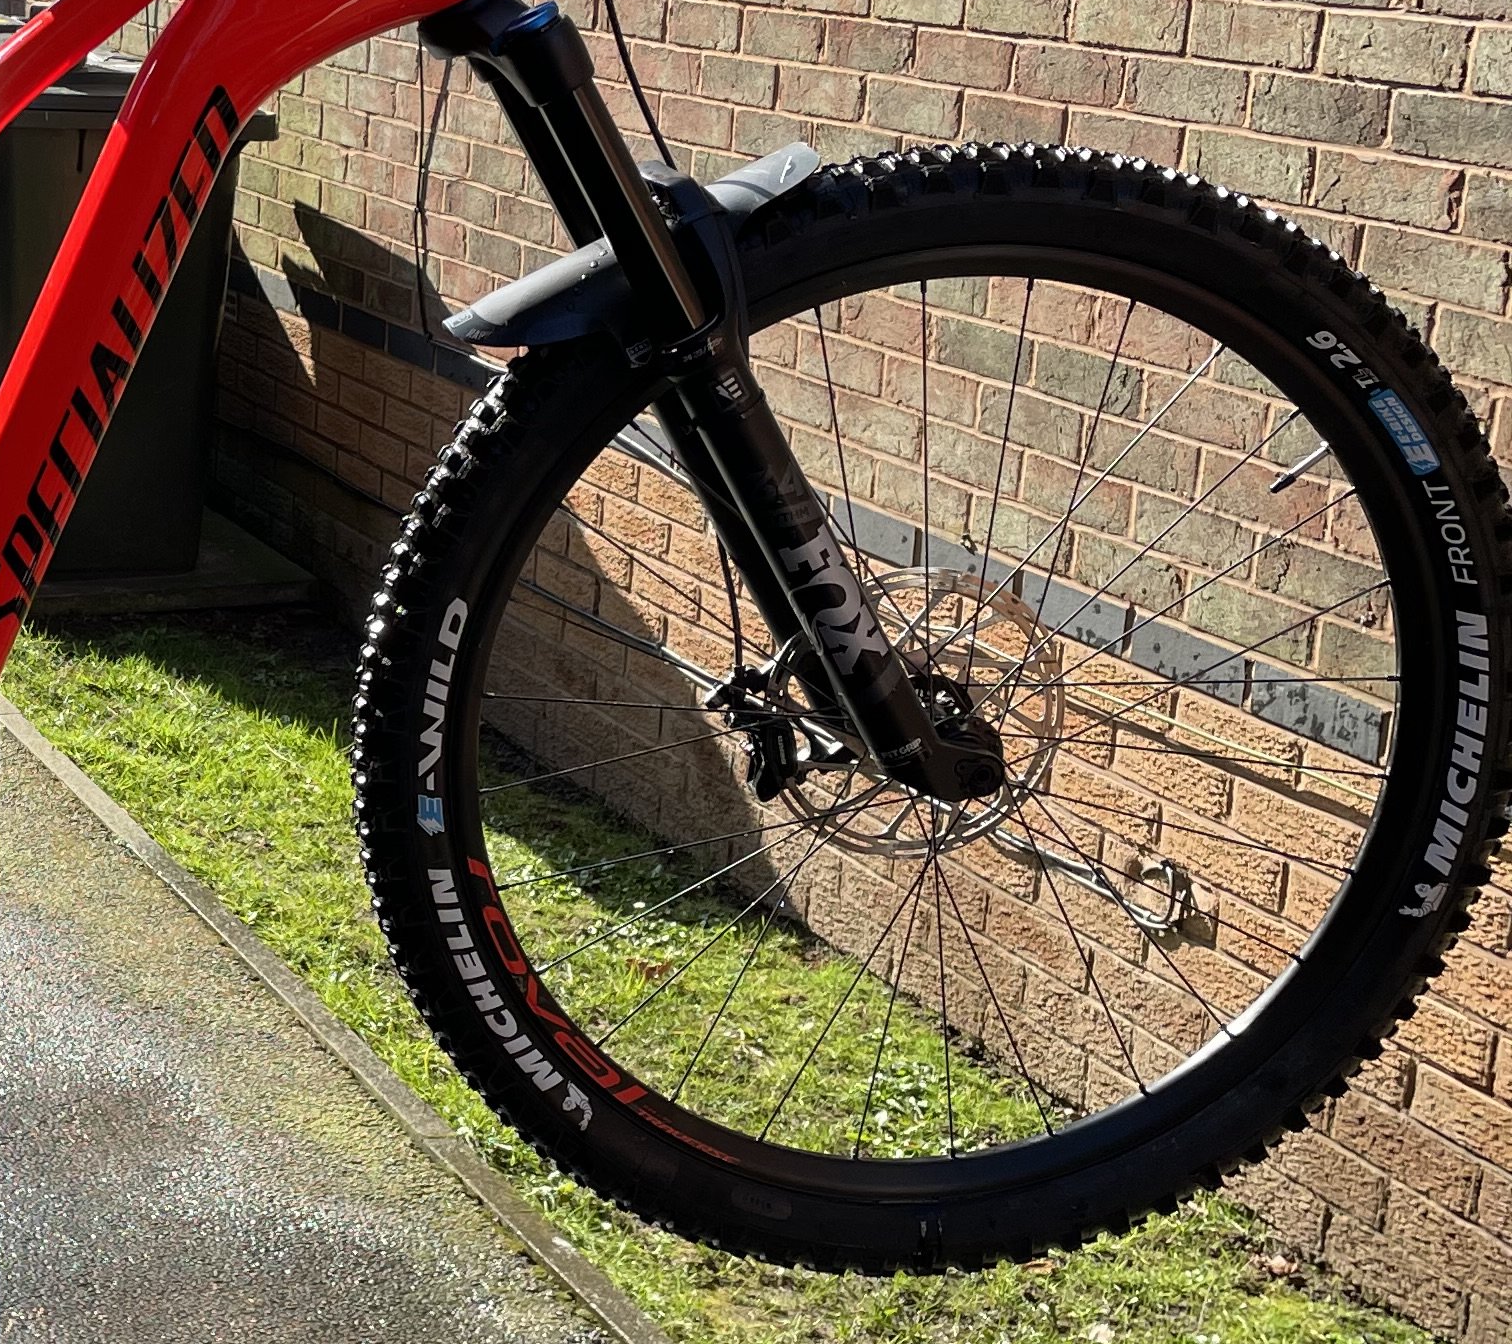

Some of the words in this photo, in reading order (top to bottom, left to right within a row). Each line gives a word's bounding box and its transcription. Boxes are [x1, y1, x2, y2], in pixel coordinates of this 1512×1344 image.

[1306, 330, 1363, 369] 2.6
[1383, 396, 1424, 442] DESIGN
[1422, 480, 1479, 586] FRONT
[778, 524, 889, 676] FOX
[1424, 609, 1490, 877] MICHELIN
[427, 868, 564, 1092] MICHELIN
